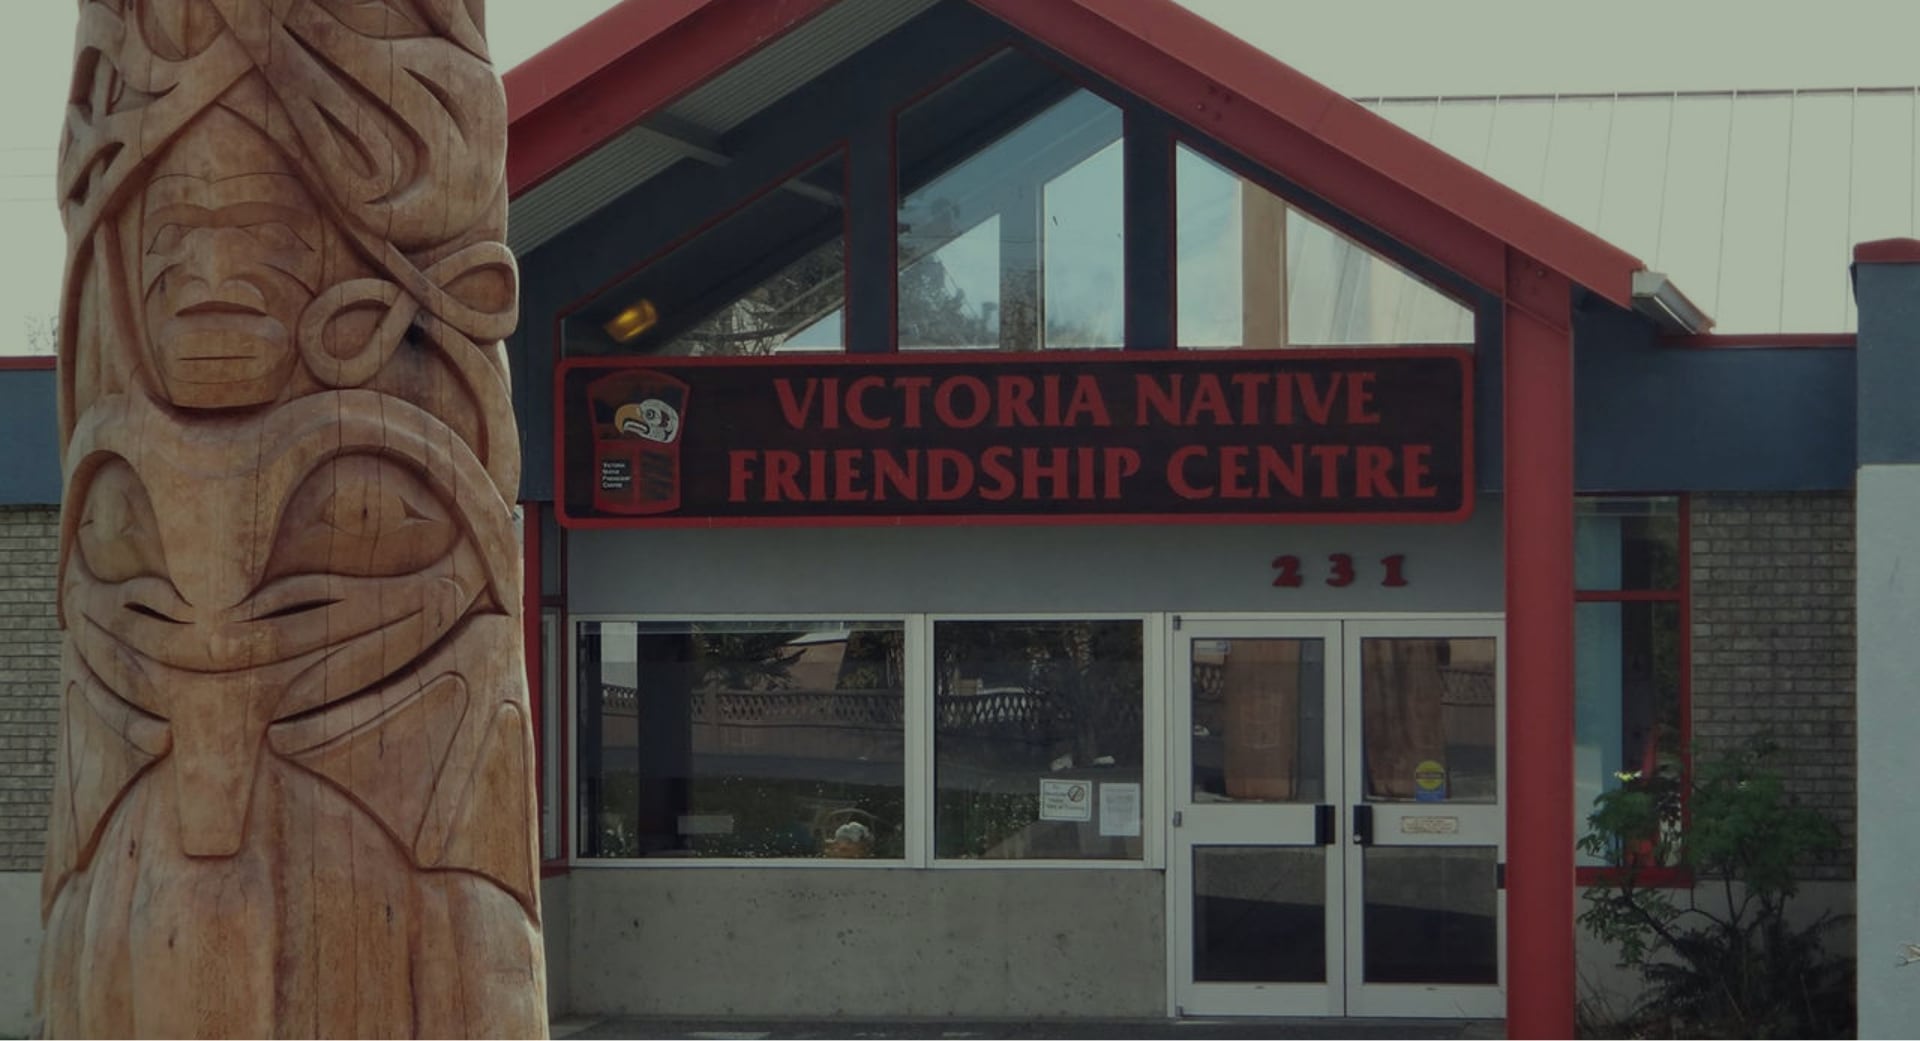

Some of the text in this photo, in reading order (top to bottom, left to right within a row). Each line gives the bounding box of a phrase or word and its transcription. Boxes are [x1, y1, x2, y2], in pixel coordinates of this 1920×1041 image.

[774, 371, 1381, 430] VICTORIA NATIVE
[729, 443, 1437, 503] FRIENDSHIP CENTRE
